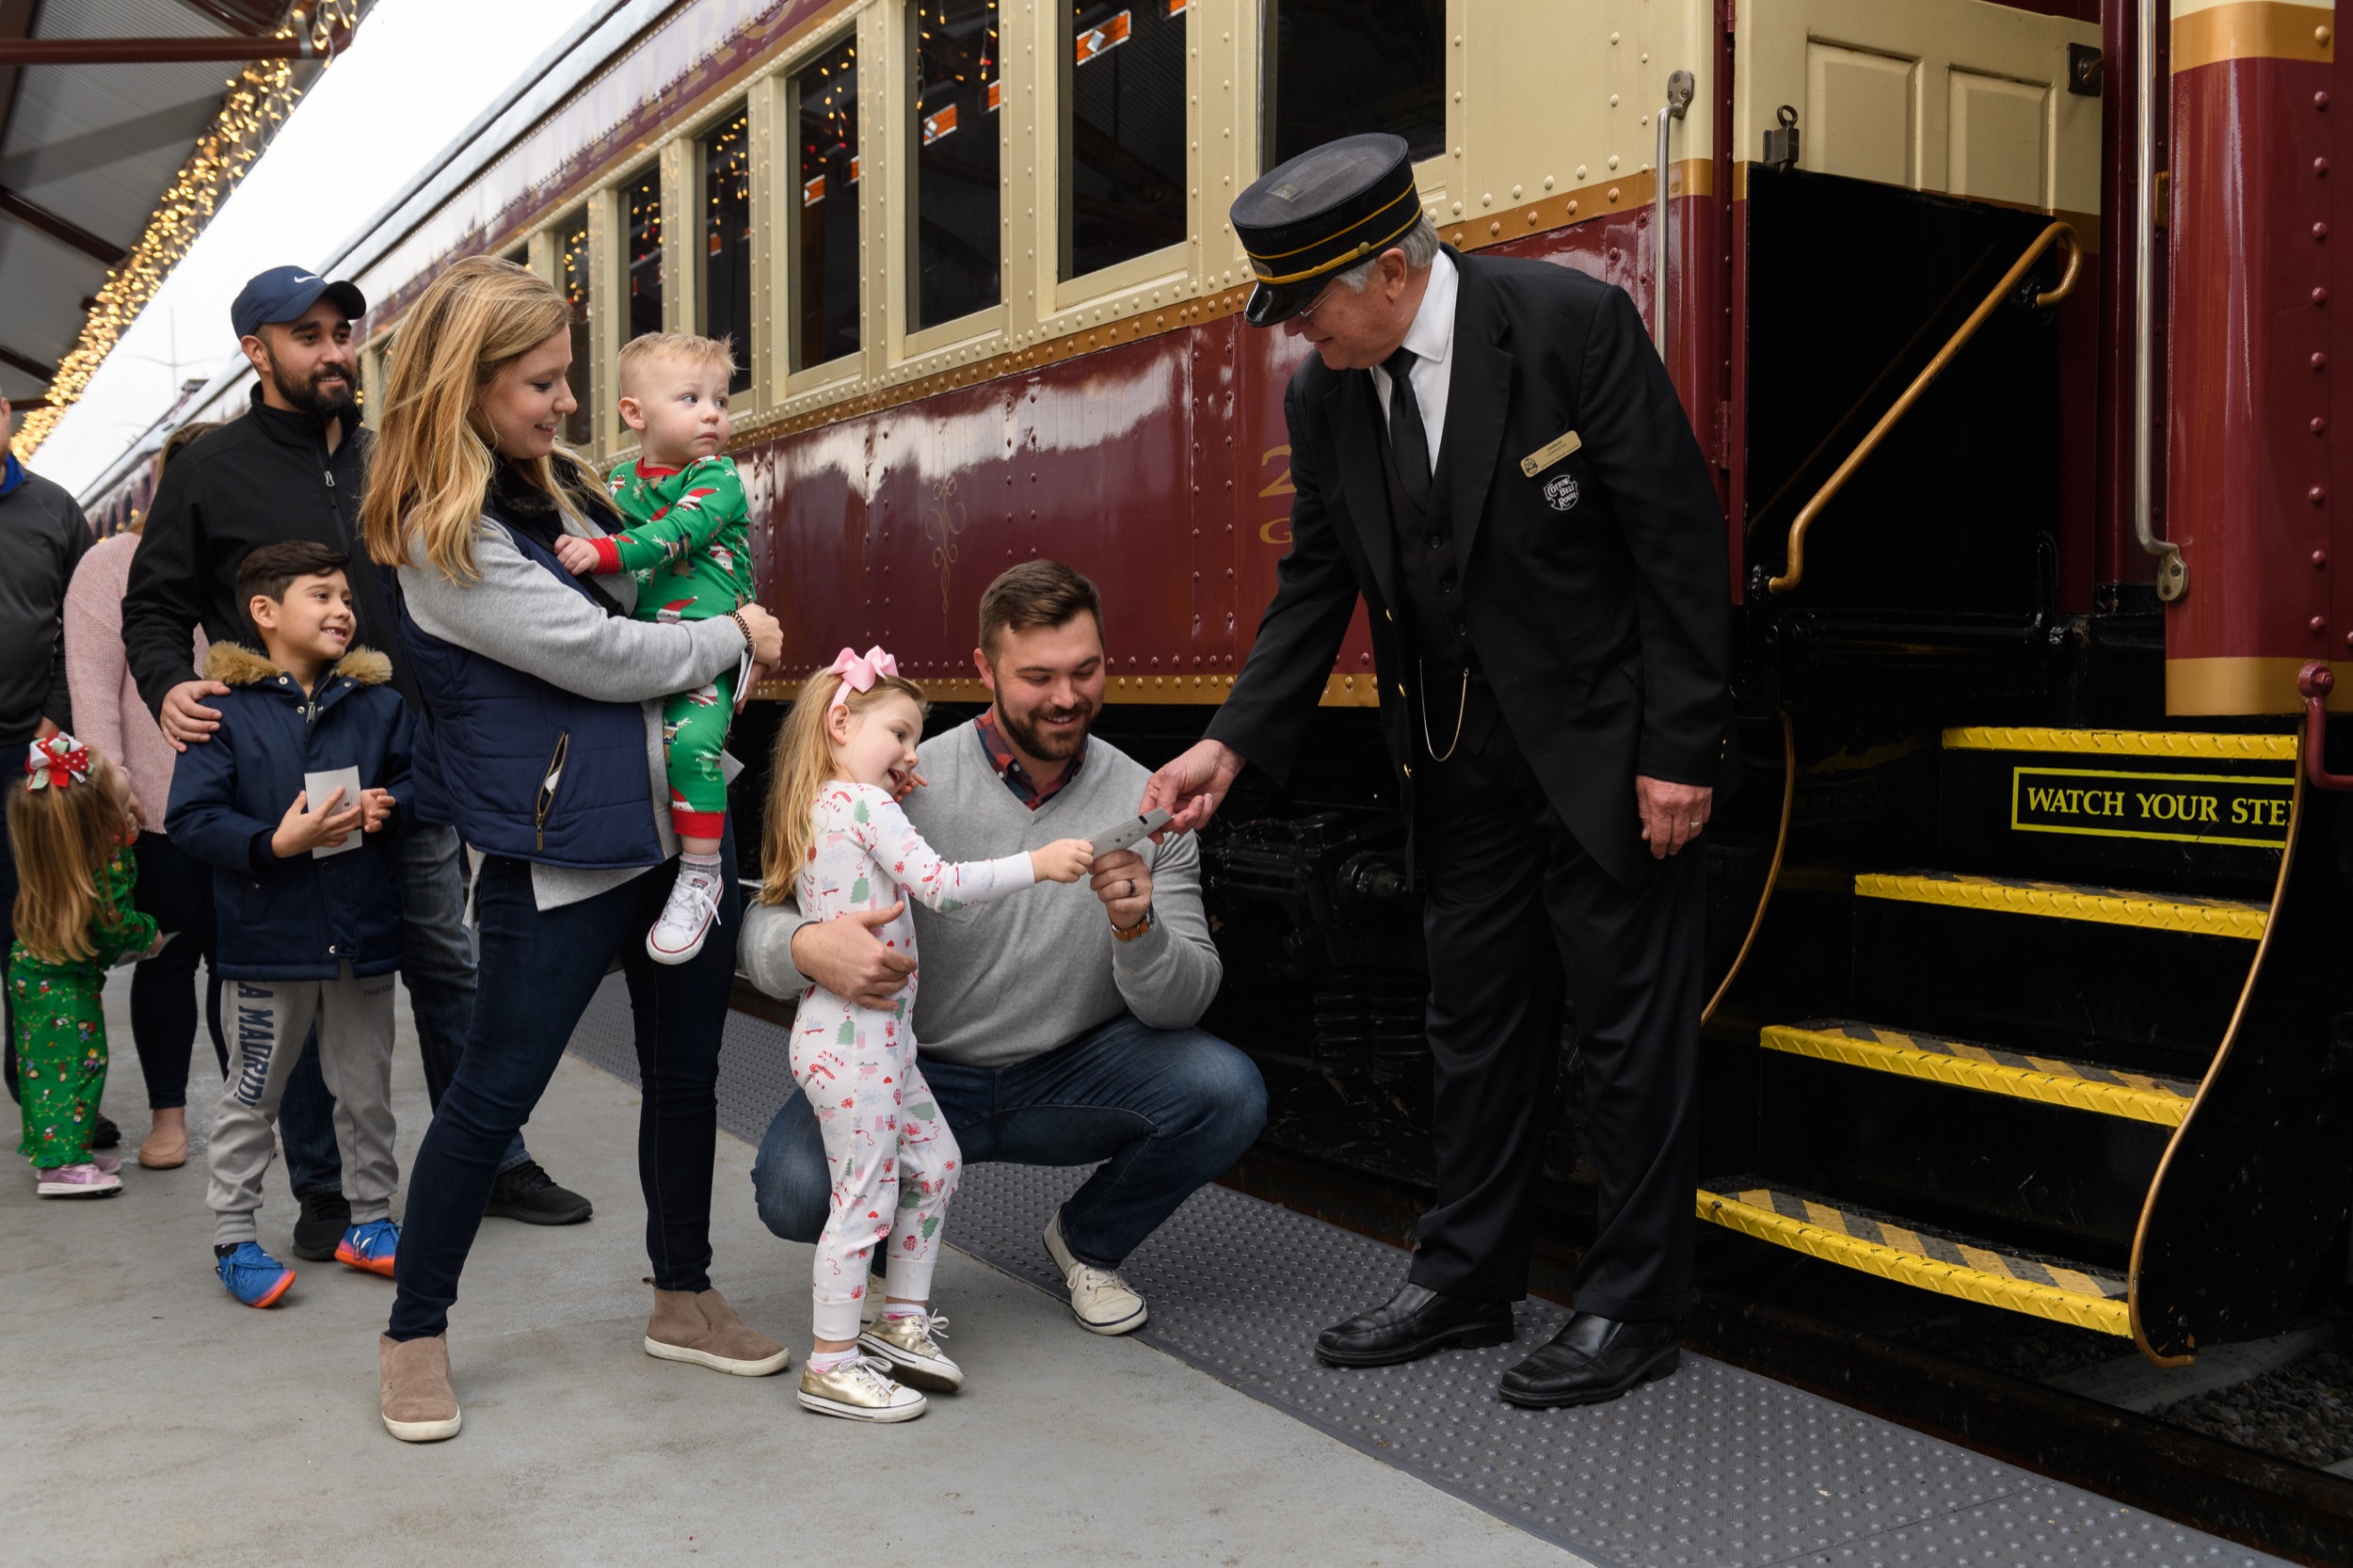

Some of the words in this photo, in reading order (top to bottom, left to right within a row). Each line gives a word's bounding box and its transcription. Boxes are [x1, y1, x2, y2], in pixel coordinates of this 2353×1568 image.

[1547, 477, 1570, 497] COTTON
[1559, 484, 1576, 497] BELT
[1558, 493, 1577, 509] ROUTE
[2027, 787, 2124, 816] WATCH
[2137, 792, 2219, 823] YOUR
[2232, 797, 2294, 826] STE
[233, 1004, 275, 1107] MADRID!
